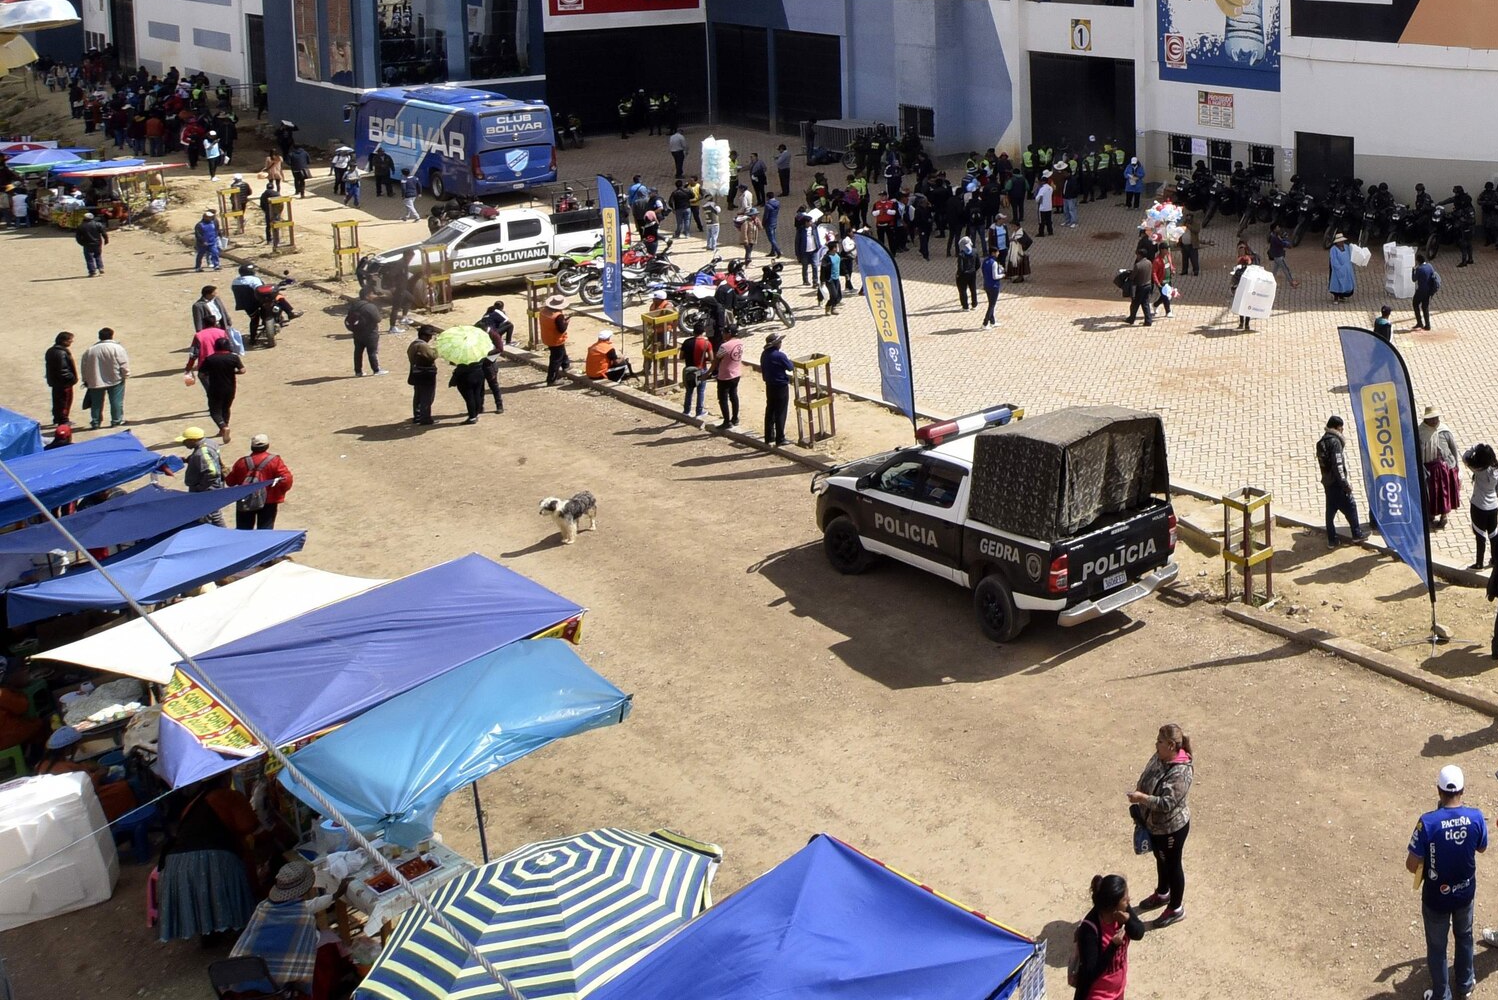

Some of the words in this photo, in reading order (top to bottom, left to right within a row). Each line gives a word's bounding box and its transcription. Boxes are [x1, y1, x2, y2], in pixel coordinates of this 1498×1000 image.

[1077, 28, 1083, 47] 1
[486, 122, 543, 134] BOLIVAR
[496, 114, 532, 125] CLUB
[368, 116, 465, 160] BOLIVAR
[453, 256, 493, 270] POLICIA
[495, 248, 547, 263] BOLIVIANA
[874, 512, 938, 548] POLICIA
[979, 538, 1020, 564] GEDRA
[1082, 538, 1157, 581] POLICIA
[1440, 816, 1471, 829] PACEÑA
